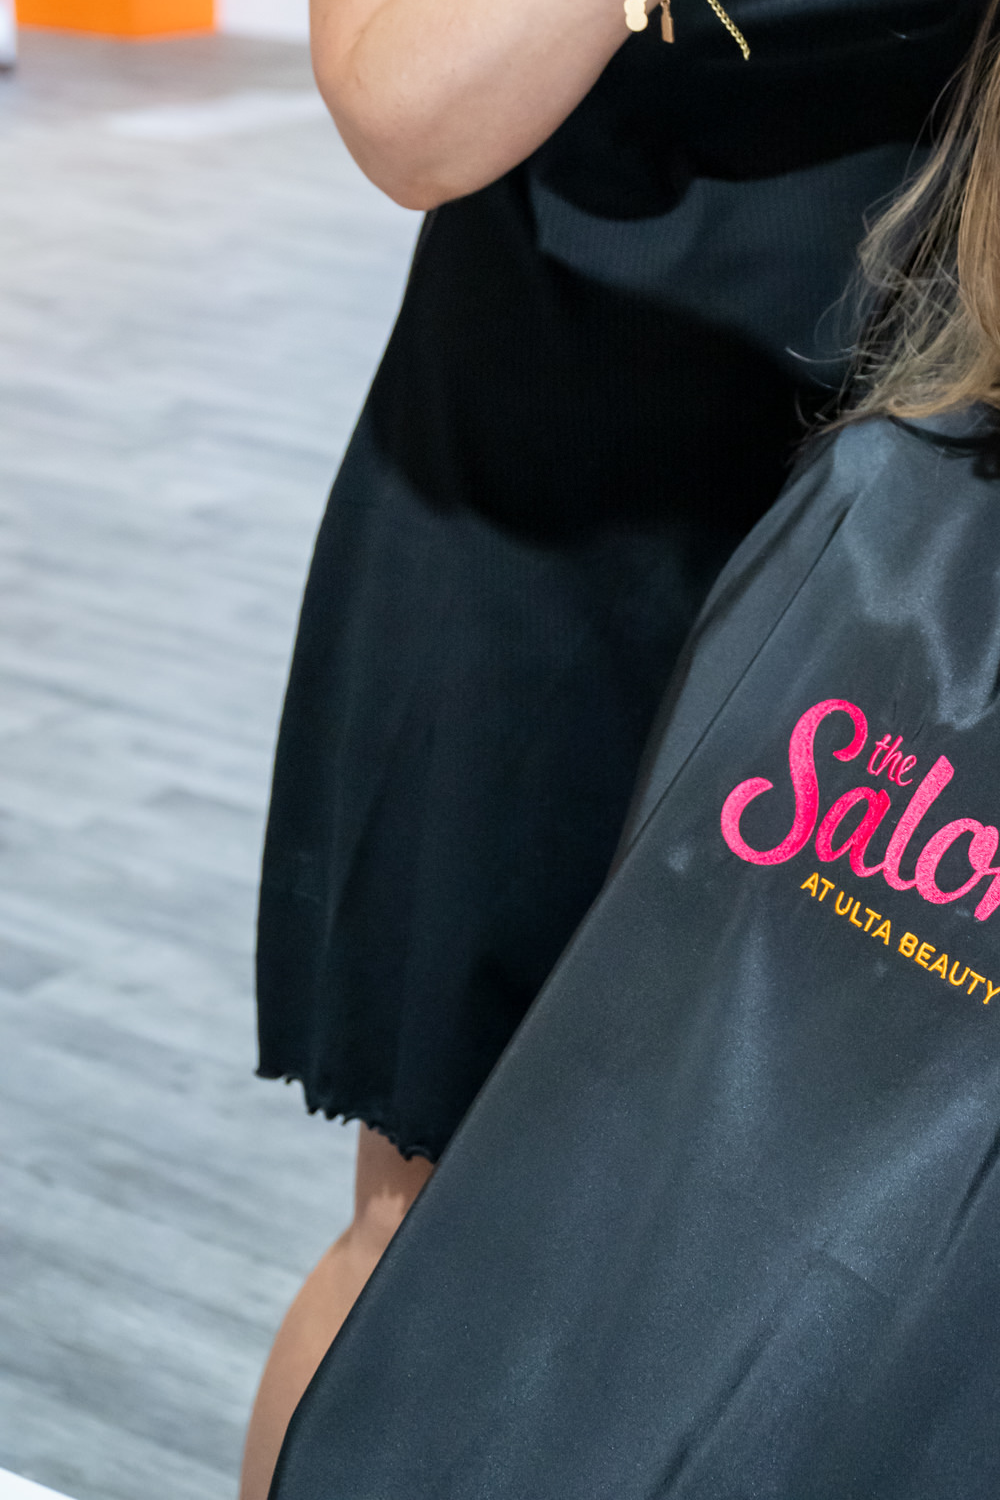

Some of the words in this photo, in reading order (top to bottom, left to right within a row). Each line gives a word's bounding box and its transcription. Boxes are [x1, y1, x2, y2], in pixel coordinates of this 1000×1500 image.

[867, 733, 917, 786] the
[800, 872, 835, 902] AT
[834, 890, 891, 946] ULTA
